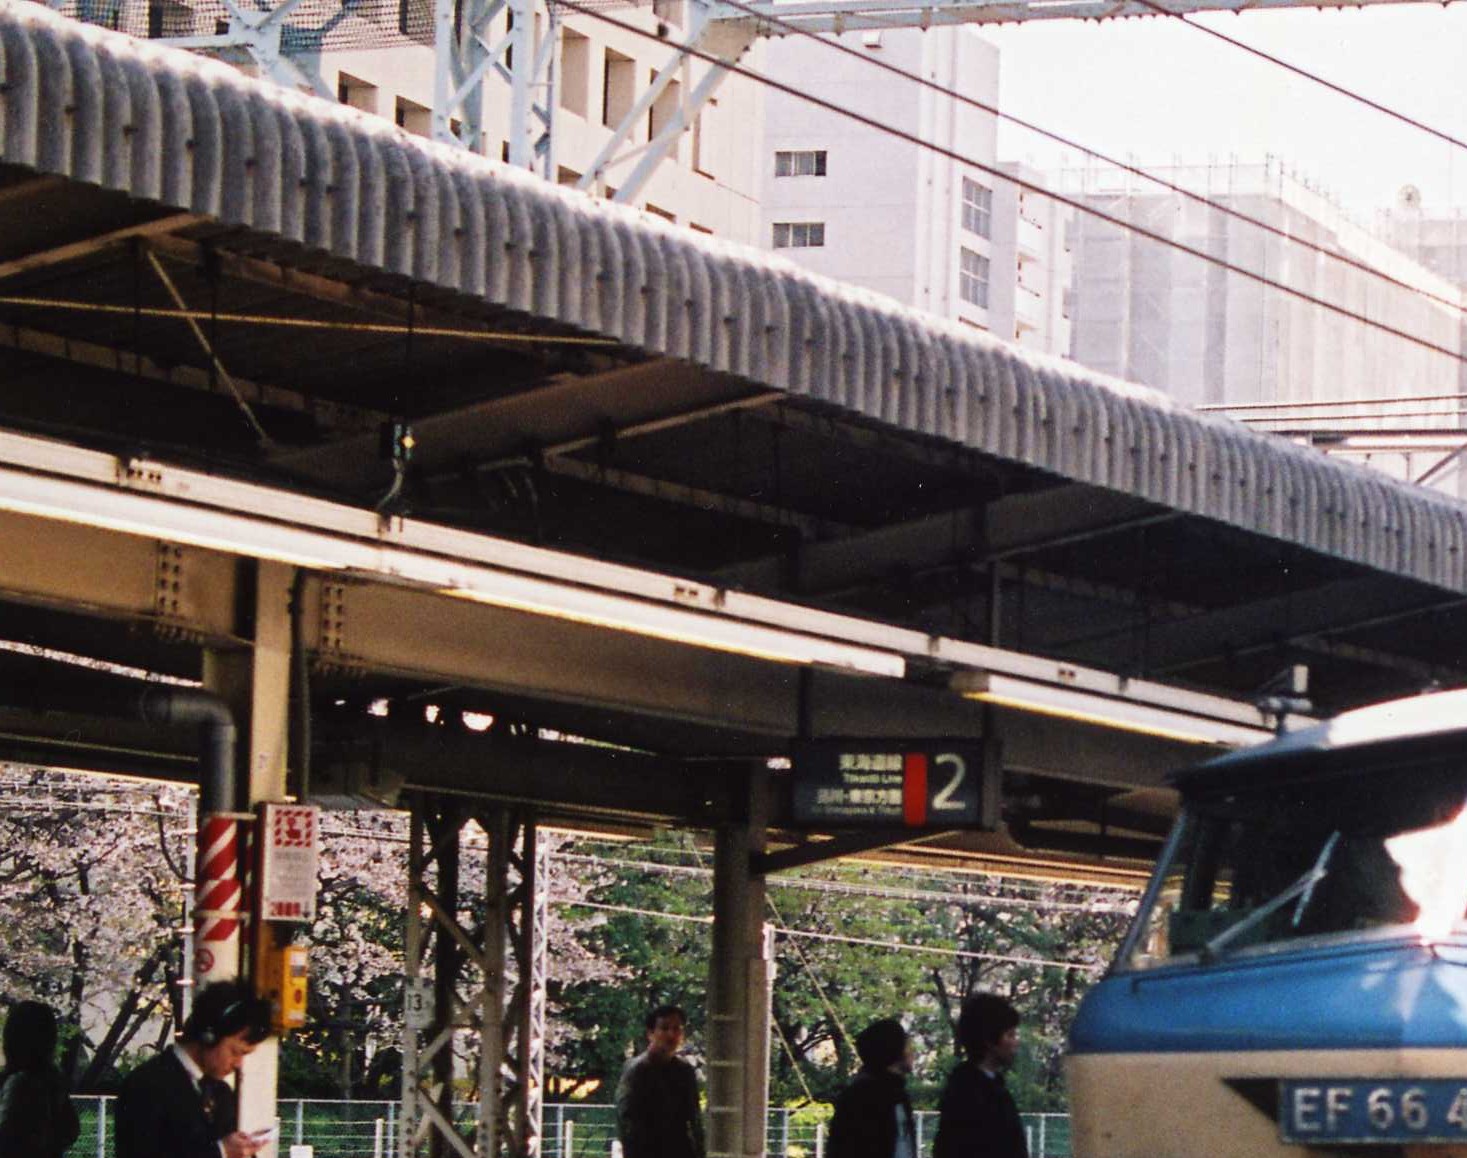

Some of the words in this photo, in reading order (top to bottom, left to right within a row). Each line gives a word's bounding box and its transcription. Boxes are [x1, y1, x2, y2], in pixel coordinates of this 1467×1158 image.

[931, 753, 966, 810] 2
[1294, 1087, 1352, 1131] EF
[1367, 1088, 1428, 1130] 66
